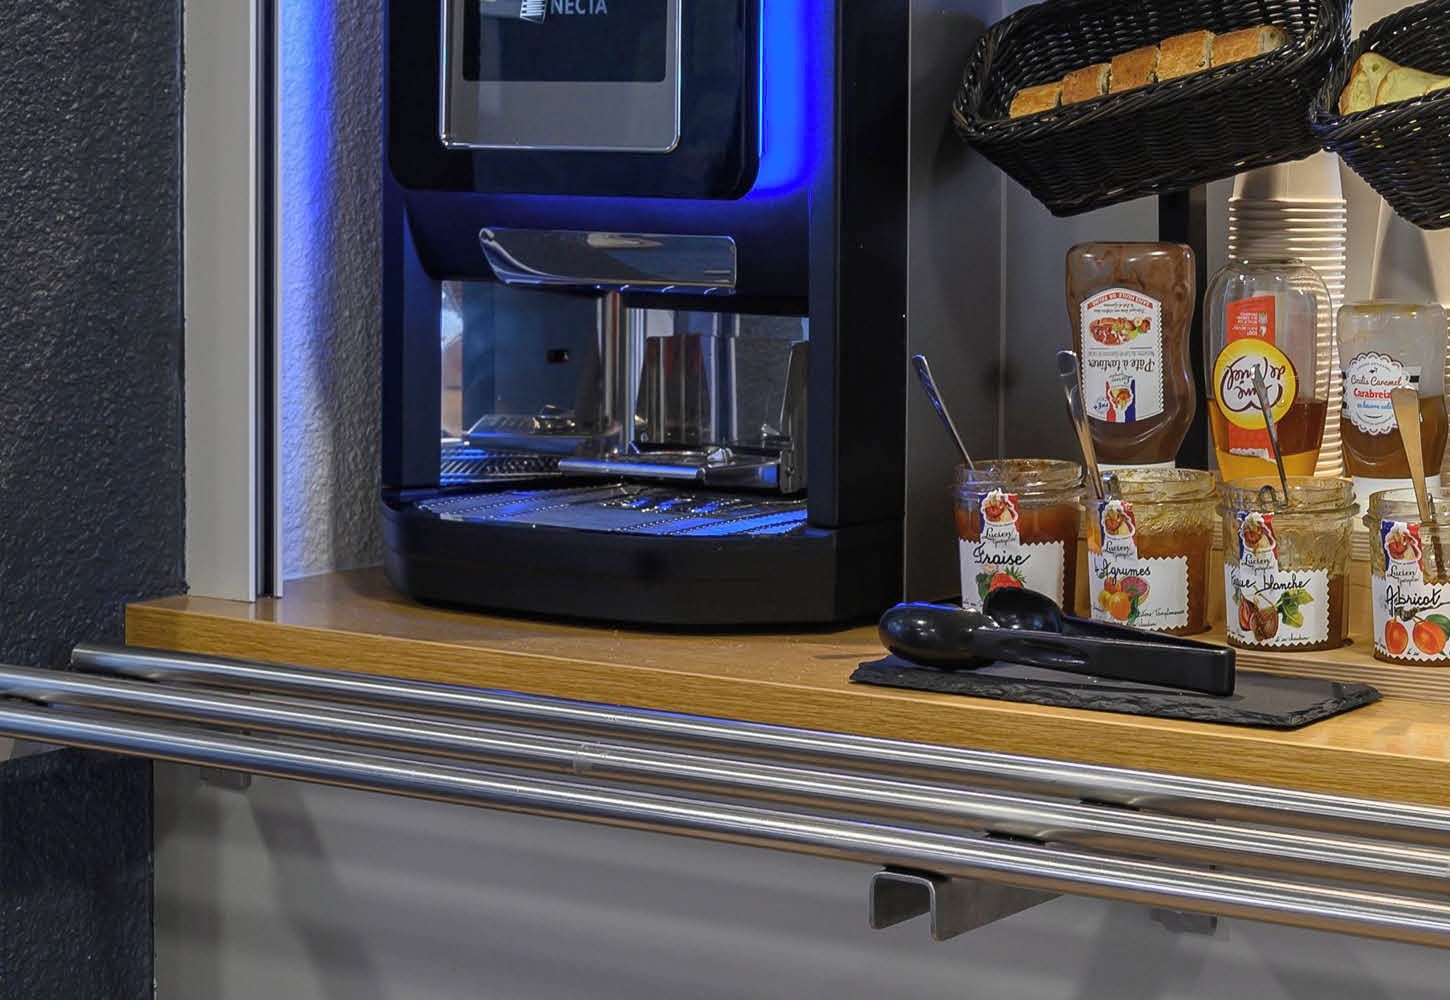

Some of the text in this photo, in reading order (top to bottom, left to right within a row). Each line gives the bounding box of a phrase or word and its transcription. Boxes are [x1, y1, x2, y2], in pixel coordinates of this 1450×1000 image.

[1088, 359, 1122, 372] tartiner
[1131, 359, 1155, 373] Pâte
[1270, 364, 1286, 380] de
[972, 542, 1031, 565] Fraise
[1255, 573, 1311, 595] blanche
